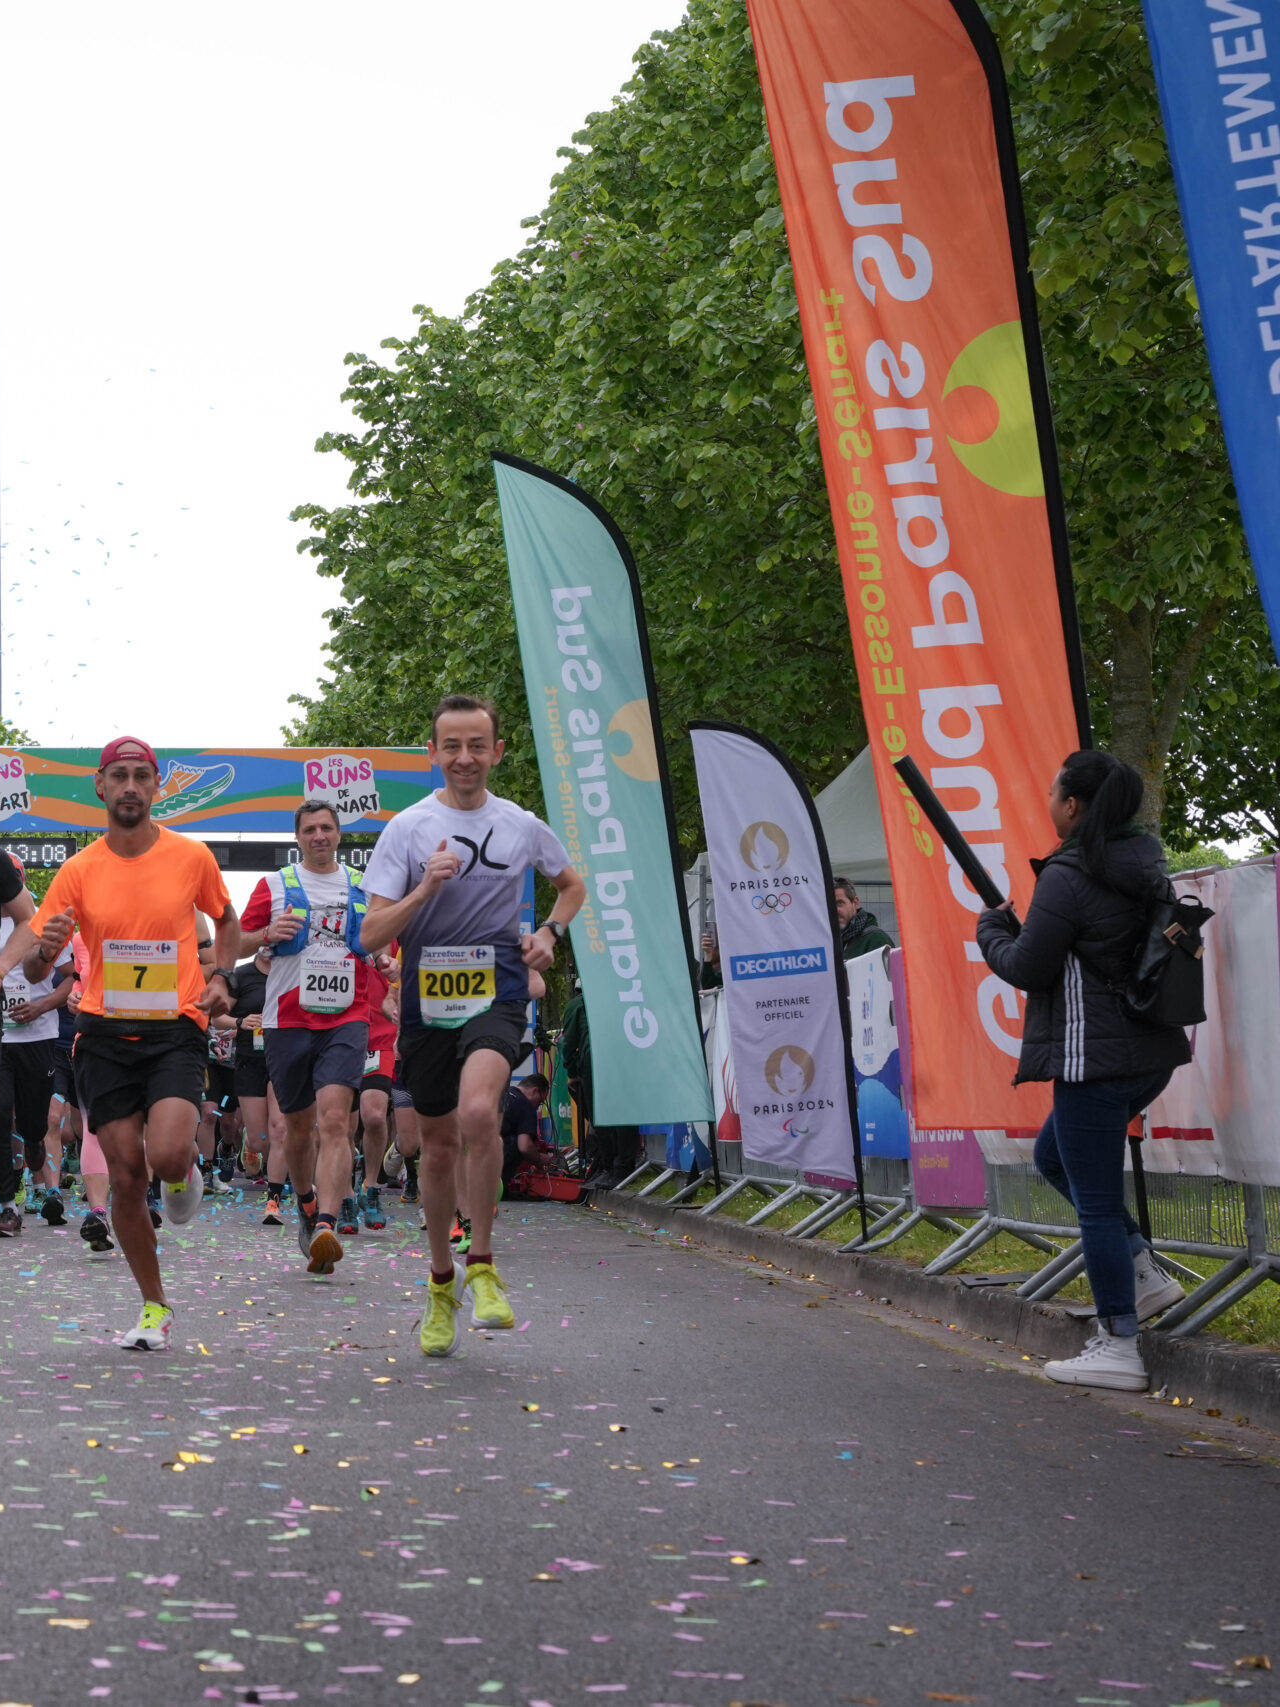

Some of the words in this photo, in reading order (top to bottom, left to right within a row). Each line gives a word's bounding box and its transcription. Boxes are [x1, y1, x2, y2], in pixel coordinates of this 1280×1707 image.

[328, 758, 343, 767] LES
[306, 760, 372, 792] RUNS
[337, 789, 350, 799] DE
[336, 793, 378, 813] NART
[730, 879, 769, 892] PARIS
[773, 875, 809, 888] 2024
[109, 943, 152, 951] Carrefour
[306, 958, 337, 966] Carrefour
[735, 953, 822, 976] DECATHLON
[133, 965, 148, 989] 7
[306, 974, 349, 993] 2040
[425, 972, 486, 997] 2002
[755, 996, 811, 1009] PARTENAIRE
[764, 1010, 805, 1022] OFFICIEL
[753, 1103, 794, 1116] PARIS
[797, 1099, 834, 1112] 2024
